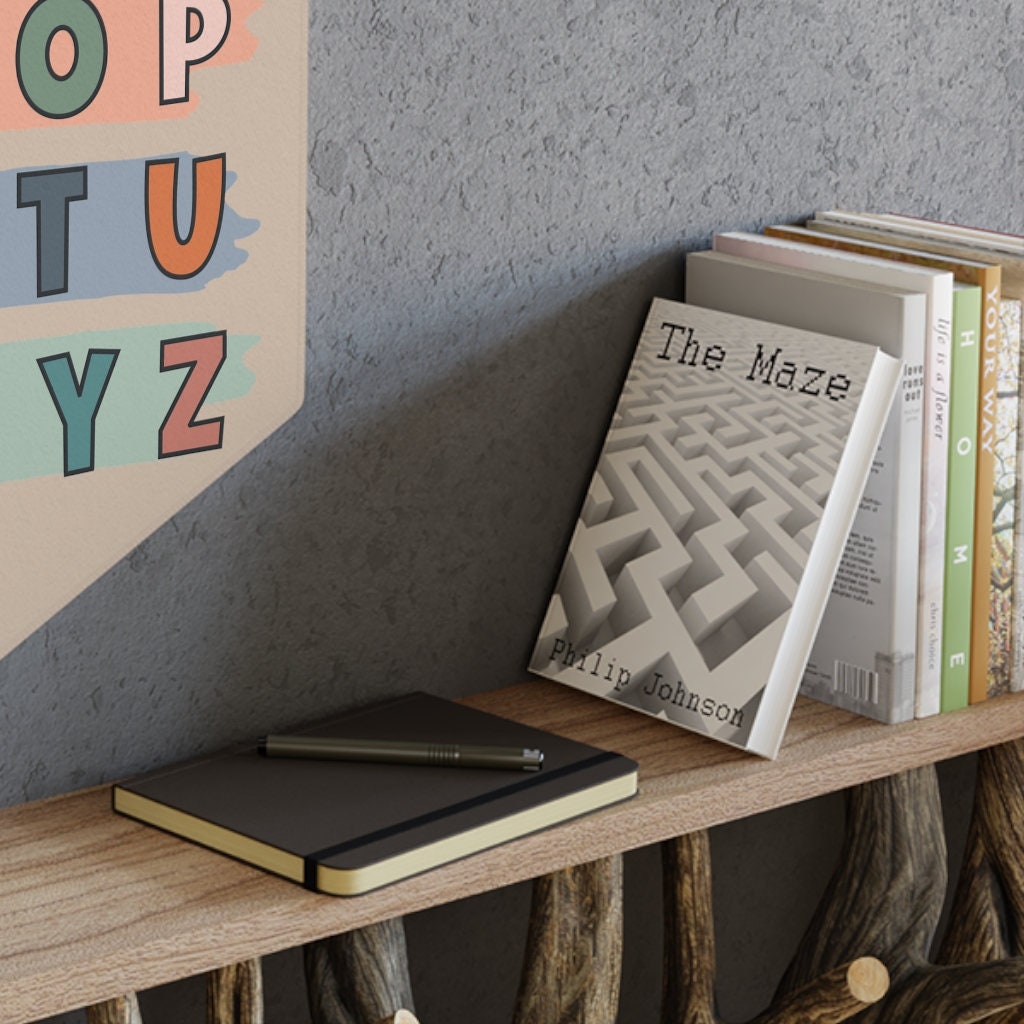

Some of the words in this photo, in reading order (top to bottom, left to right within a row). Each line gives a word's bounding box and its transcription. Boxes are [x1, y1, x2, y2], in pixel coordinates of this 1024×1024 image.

[16, 165, 88, 298] T
[144, 152, 227, 280] U
[933, 318, 950, 343] life
[936, 352, 946, 366] is
[983, 286, 998, 379] YOUR
[657, 322, 726, 371] The
[746, 343, 852, 402] Maze
[902, 376, 924, 389] runs
[903, 363, 924, 376] love
[36, 348, 121, 478] Y
[157, 330, 227, 460] Z
[904, 388, 921, 402] out
[931, 387, 948, 440] flower
[981, 388, 994, 454] WAY
[549, 638, 631, 691] Philip
[643, 673, 745, 727] Johnson
